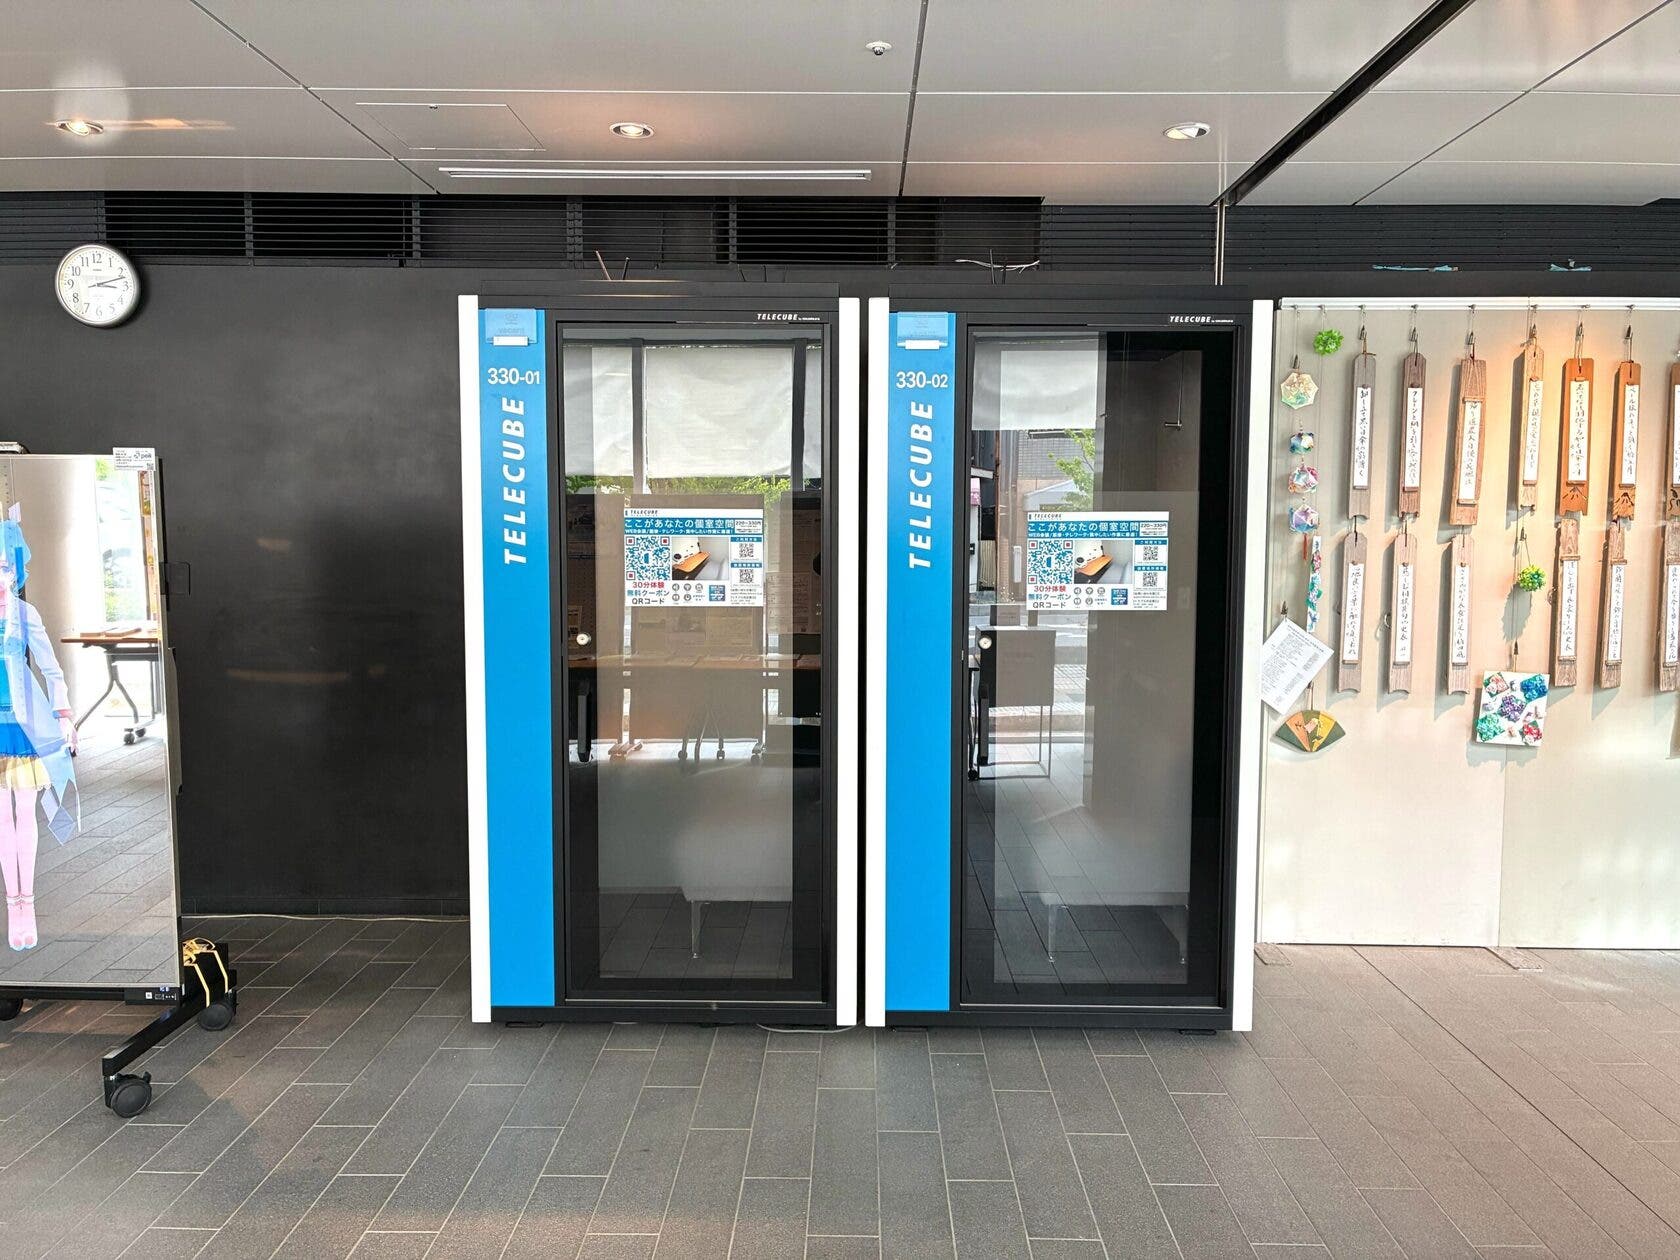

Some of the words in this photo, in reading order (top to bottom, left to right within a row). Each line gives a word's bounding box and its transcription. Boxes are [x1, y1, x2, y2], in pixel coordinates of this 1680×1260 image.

[81, 256, 90, 267] 11
[92, 253, 102, 264] 12
[108, 257, 113, 268] 1
[71, 266, 81, 276] 10
[67, 279, 74, 289] 9
[123, 281, 129, 291] 3
[72, 292, 79, 303] 8
[84, 302, 90, 313] 7
[96, 305, 103, 316] 6
[757, 313, 798, 321] TELECUBE
[1170, 315, 1211, 323] TELECUBE
[487, 367, 540, 384] 330-01
[896, 371, 948, 388] 330-02
[502, 397, 527, 565] TELECUBE
[909, 401, 933, 569] TELECUBE
[625, 519, 735, 529] ここがあなたの個室空間
[1028, 522, 1139, 532] ここがあなたの個室空間
[627, 589, 670, 597] 無料クーポン
[1033, 585, 1067, 593] 30分体験
